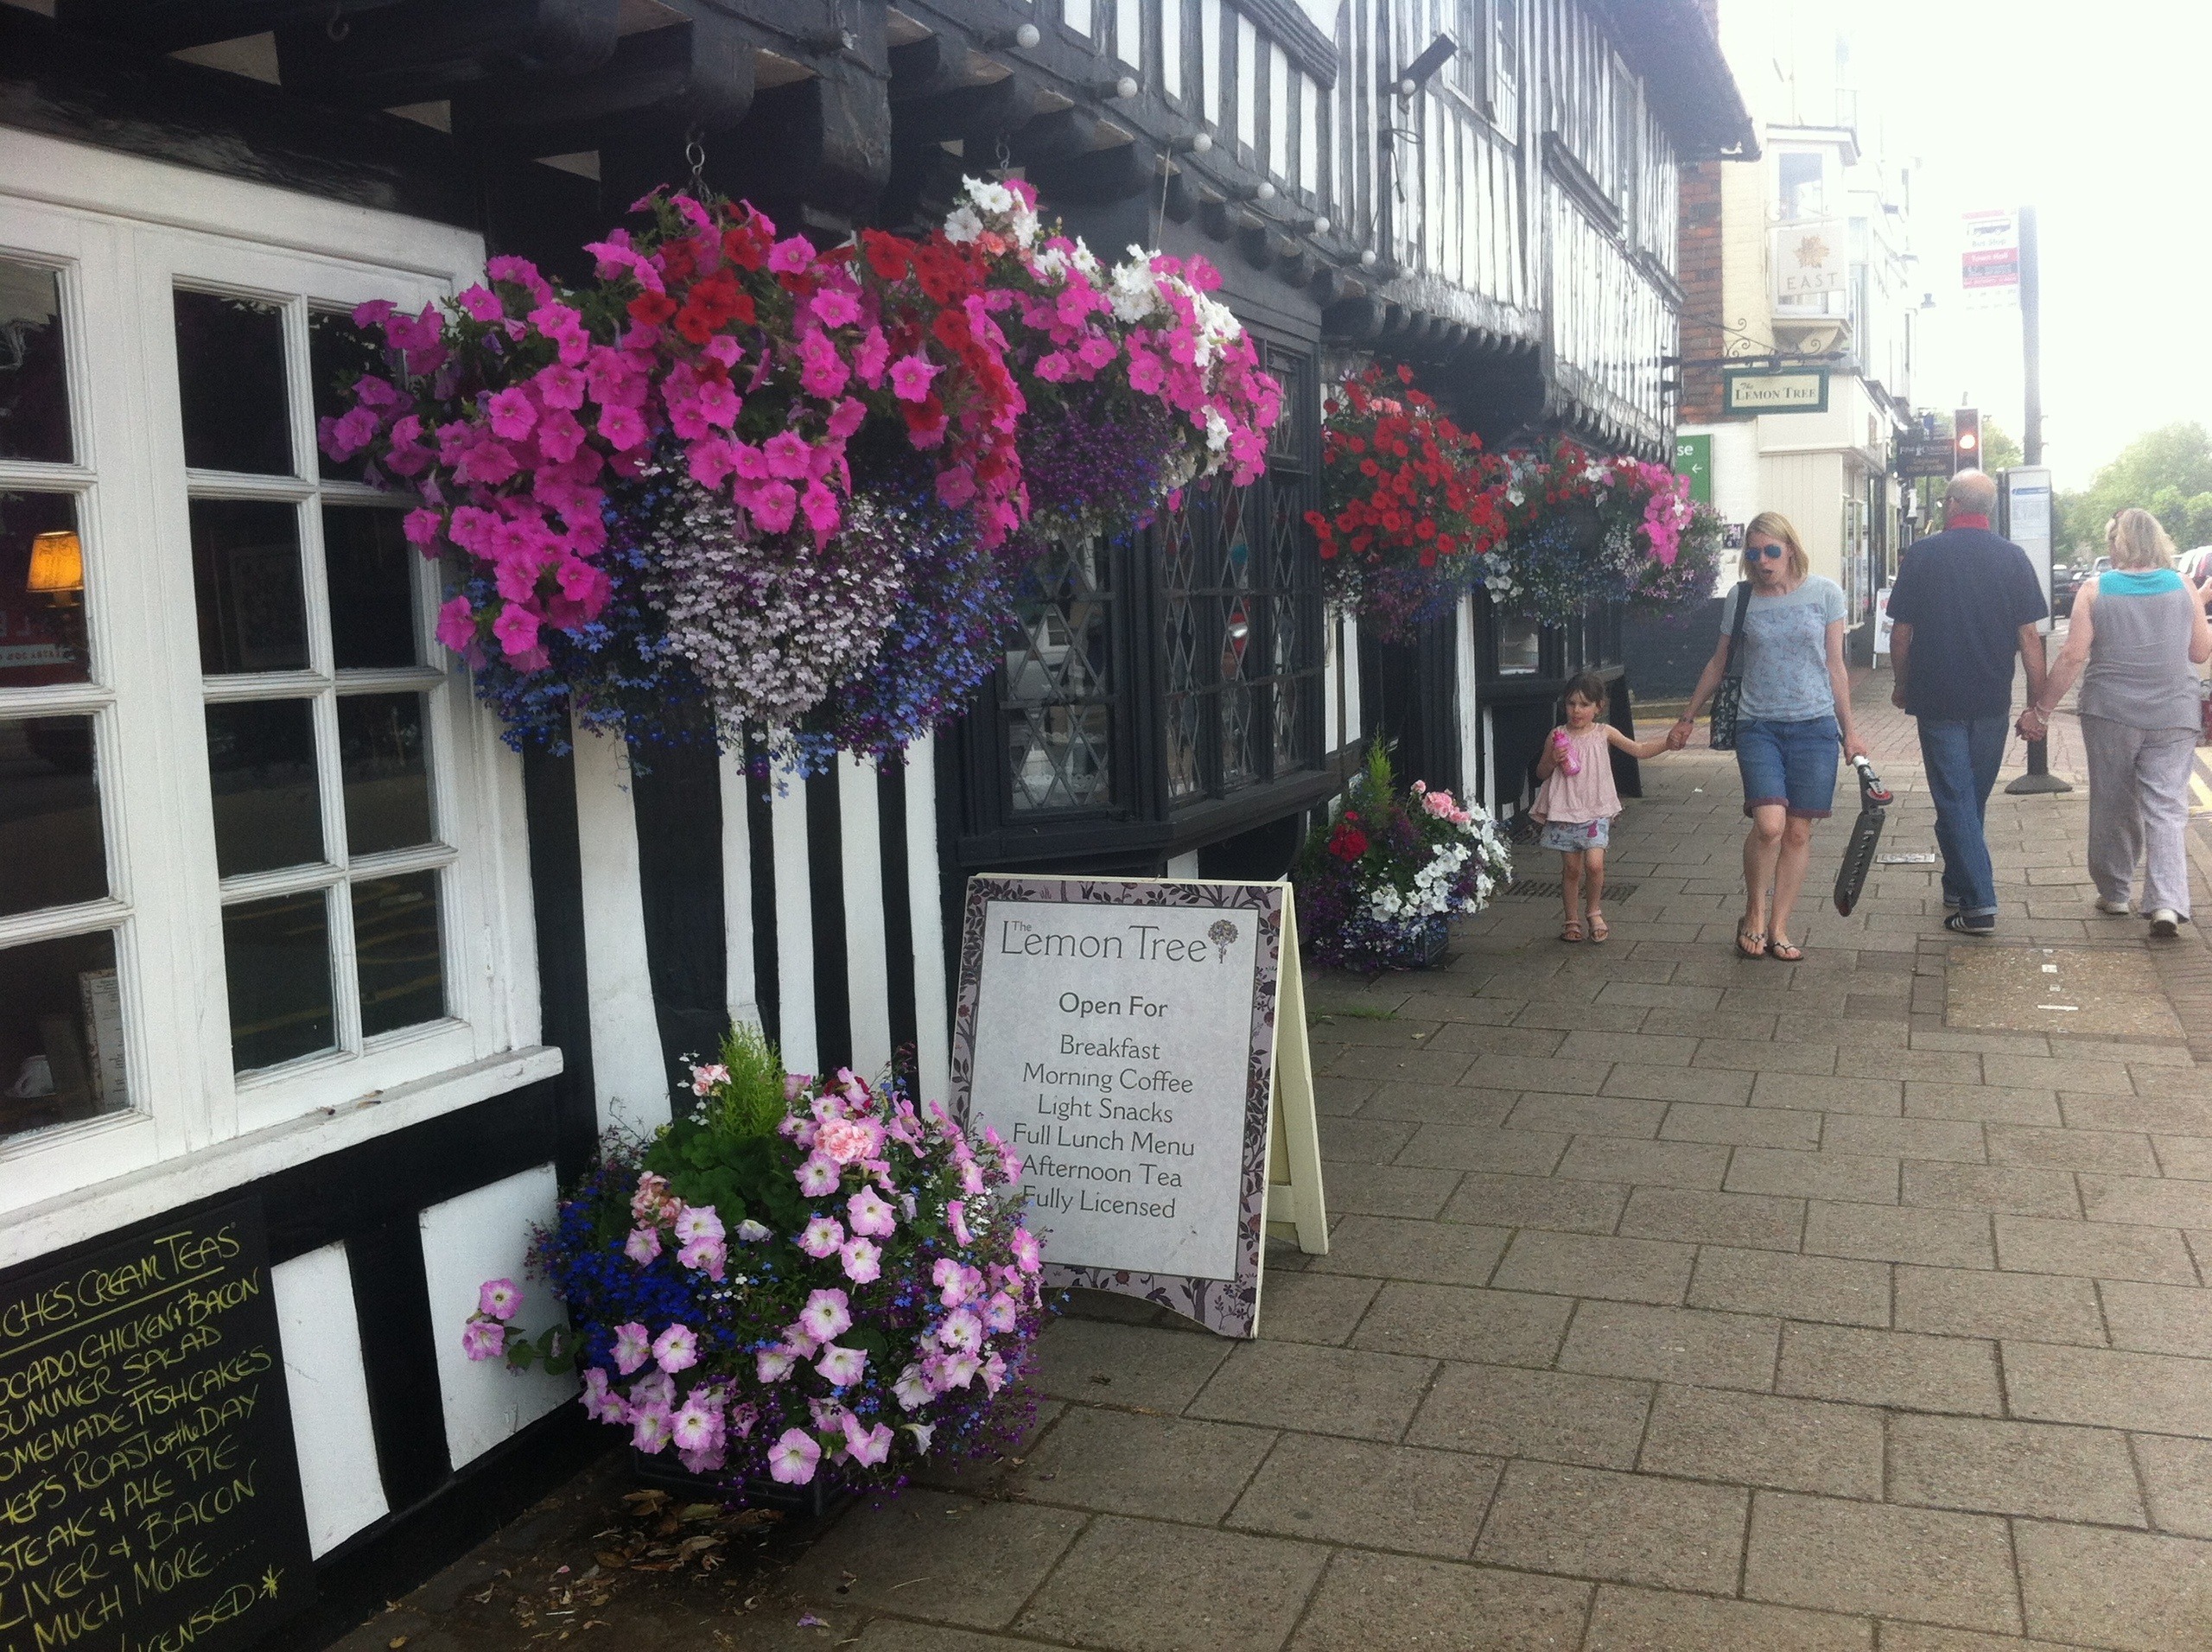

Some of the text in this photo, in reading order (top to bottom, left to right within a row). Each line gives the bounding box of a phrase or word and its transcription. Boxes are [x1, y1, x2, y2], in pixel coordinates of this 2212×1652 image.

[1787, 272, 1838, 290] EAST
[1001, 920, 1207, 963] Lemon Tree
[1012, 921, 1032, 932] The
[1058, 992, 1168, 1019] Open For
[1060, 1034, 1160, 1060] Breakfast
[1022, 1063, 1193, 1094] Morning Coffee
[1038, 1094, 1173, 1123] Light Snacks
[1013, 1123, 1195, 1157] Full Lunch Menu
[1020, 1154, 1182, 1188] Afternoon Tea
[1080, 1190, 1175, 1219] Licensed
[78, 1255, 166, 1306] CREAM
[153, 1226, 240, 1274] TEAS
[79, 1301, 175, 1369] CHICKEN
[178, 1267, 259, 1327] BACON
[122, 1325, 222, 1382] SALAD
[122, 1345, 271, 1426] FISHCAKES
[64, 1430, 153, 1493] ROAST
[193, 1383, 259, 1436] DAY
[124, 1469, 175, 1517] ALE
[175, 1433, 239, 1482] PIE
[137, 1458, 257, 1553] BACON
[33, 1585, 124, 1652] MUCH
